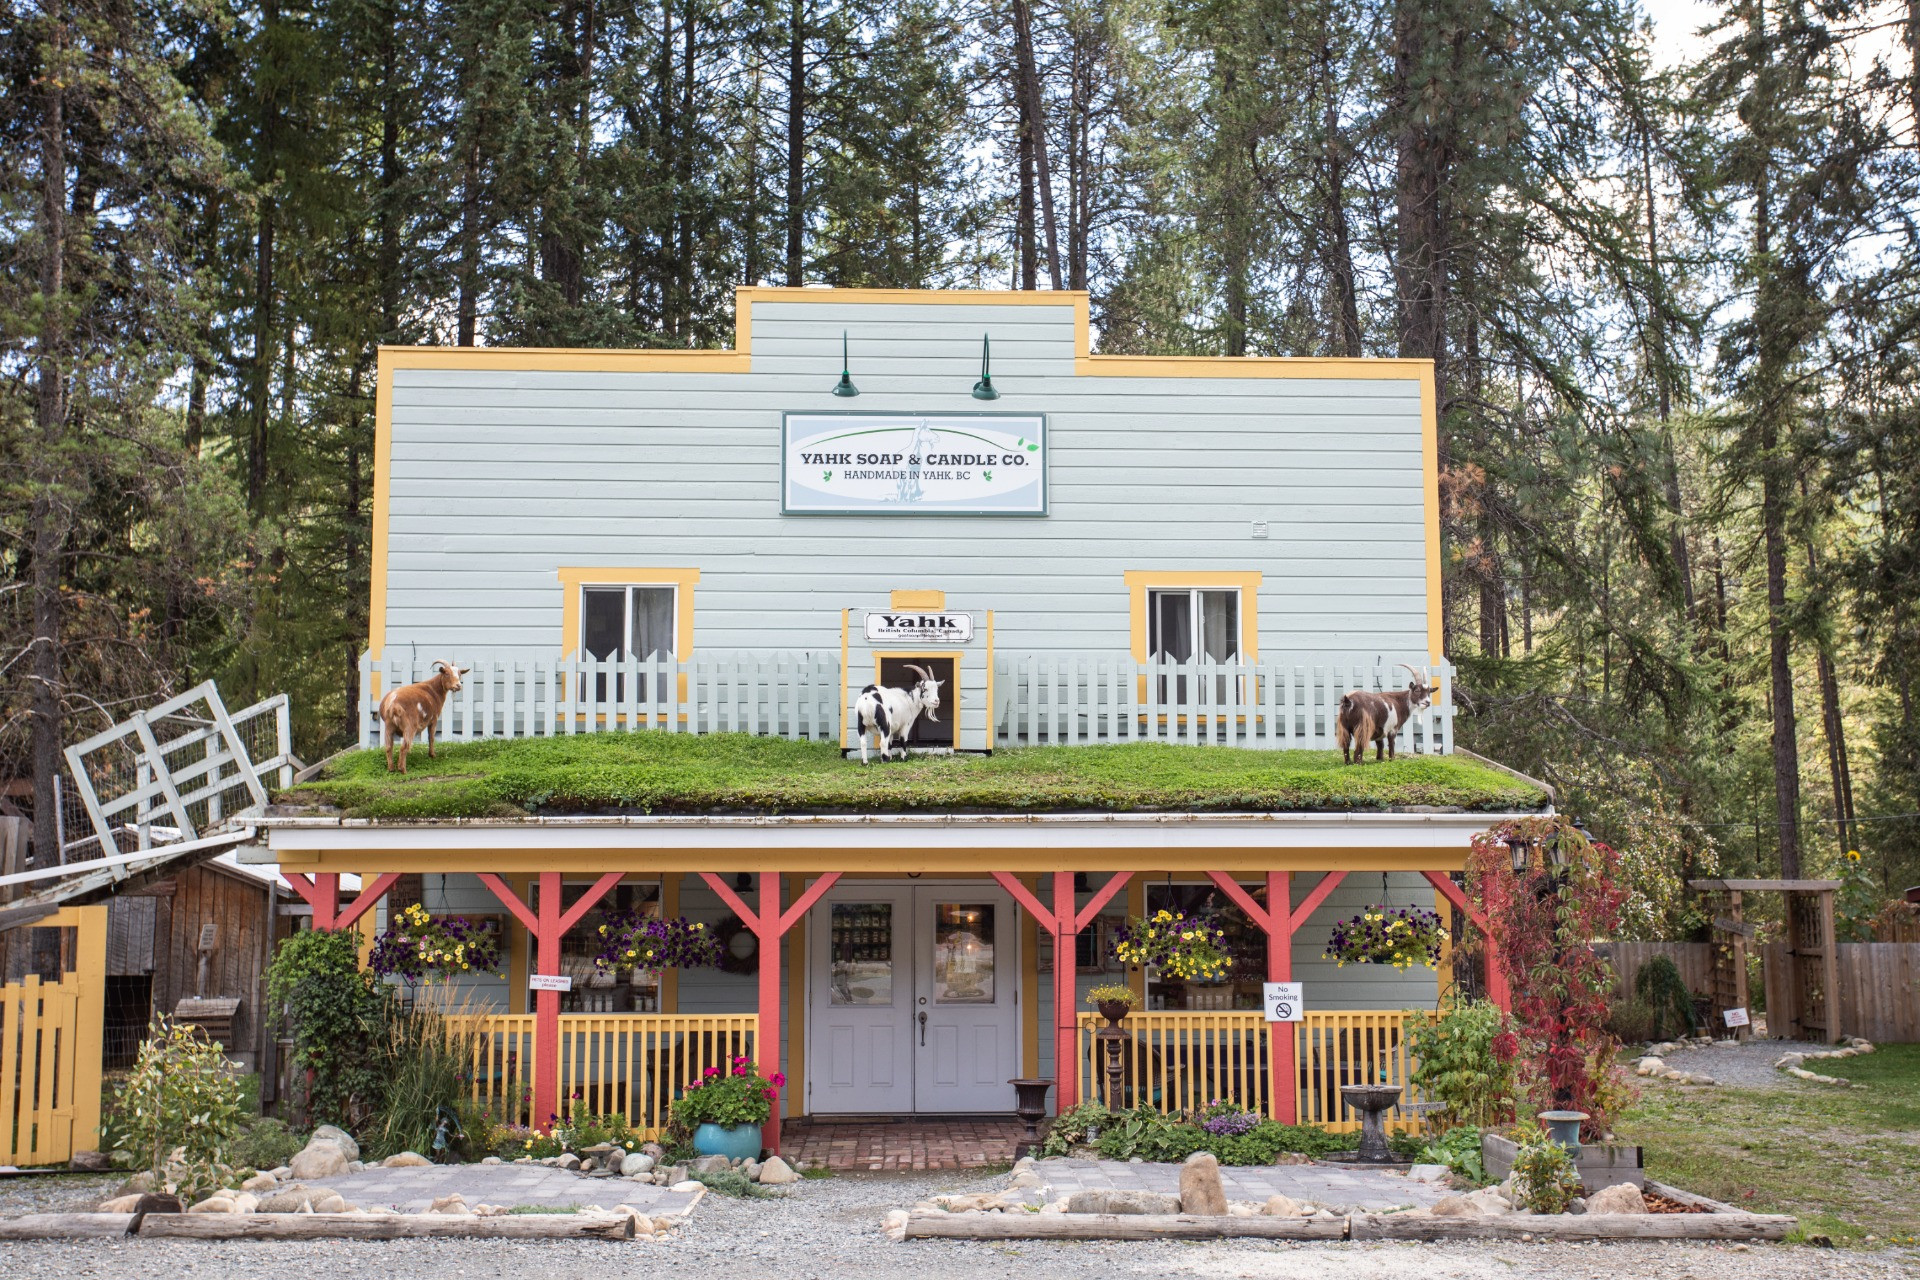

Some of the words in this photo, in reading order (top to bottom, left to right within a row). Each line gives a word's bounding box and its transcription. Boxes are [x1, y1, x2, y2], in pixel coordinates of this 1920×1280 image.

[801, 453, 852, 465] YAHK
[857, 453, 903, 466] SOAP
[908, 454, 921, 466] &
[926, 454, 997, 466] CANDLE
[1002, 454, 1029, 466] CO.
[844, 470, 907, 480] HANDMADE
[908, 471, 920, 480] IN
[956, 471, 971, 480] BC
[881, 616, 957, 628] Yahk
[1269, 993, 1298, 1001] Smoking
